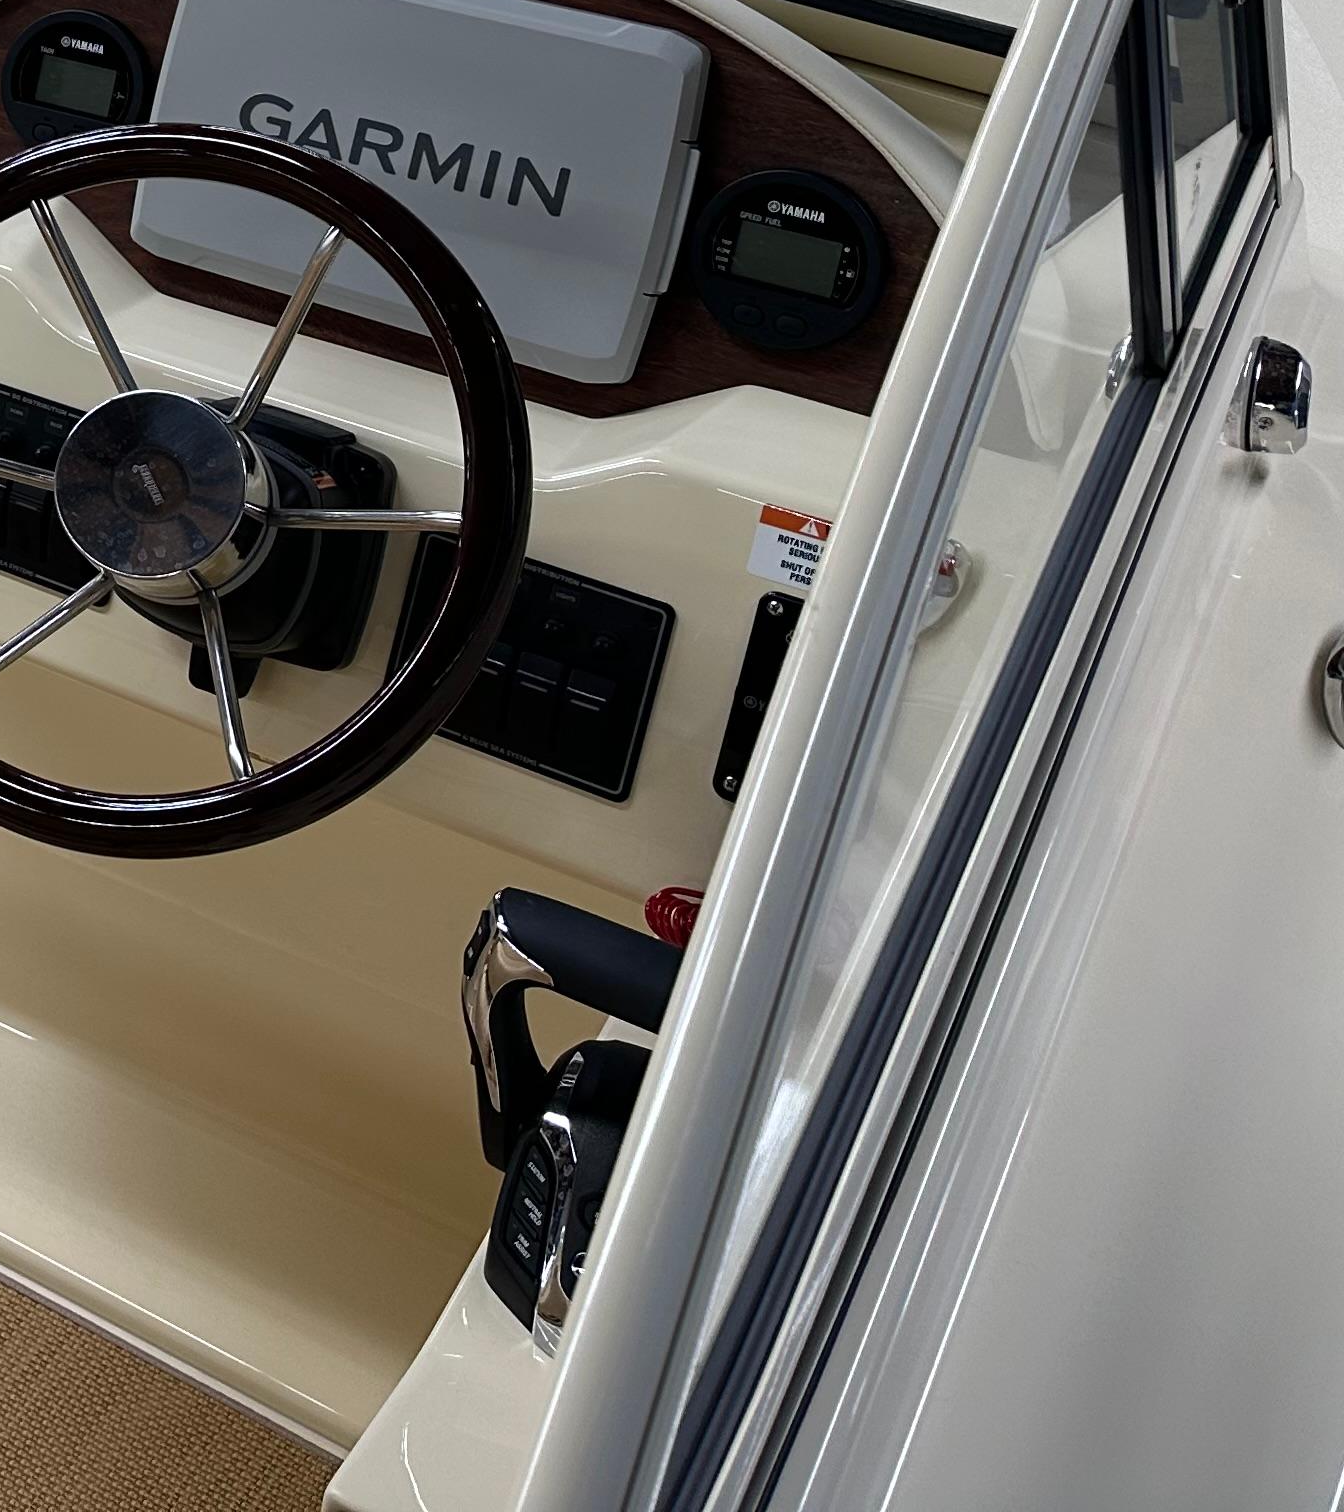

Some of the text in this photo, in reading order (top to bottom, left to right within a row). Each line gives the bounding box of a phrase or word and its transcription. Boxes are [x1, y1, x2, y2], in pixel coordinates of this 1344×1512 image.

[71, 39, 104, 55] YAMAHA
[239, 93, 572, 217] GARMIN
[740, 210, 782, 227] SPEED FUEL
[781, 203, 825, 223] YAMAHA
[777, 534, 819, 553] ROTATING
[788, 547, 820, 563] SERIOU
[780, 560, 816, 576] SHUT OF
[789, 572, 812, 585] PERS
